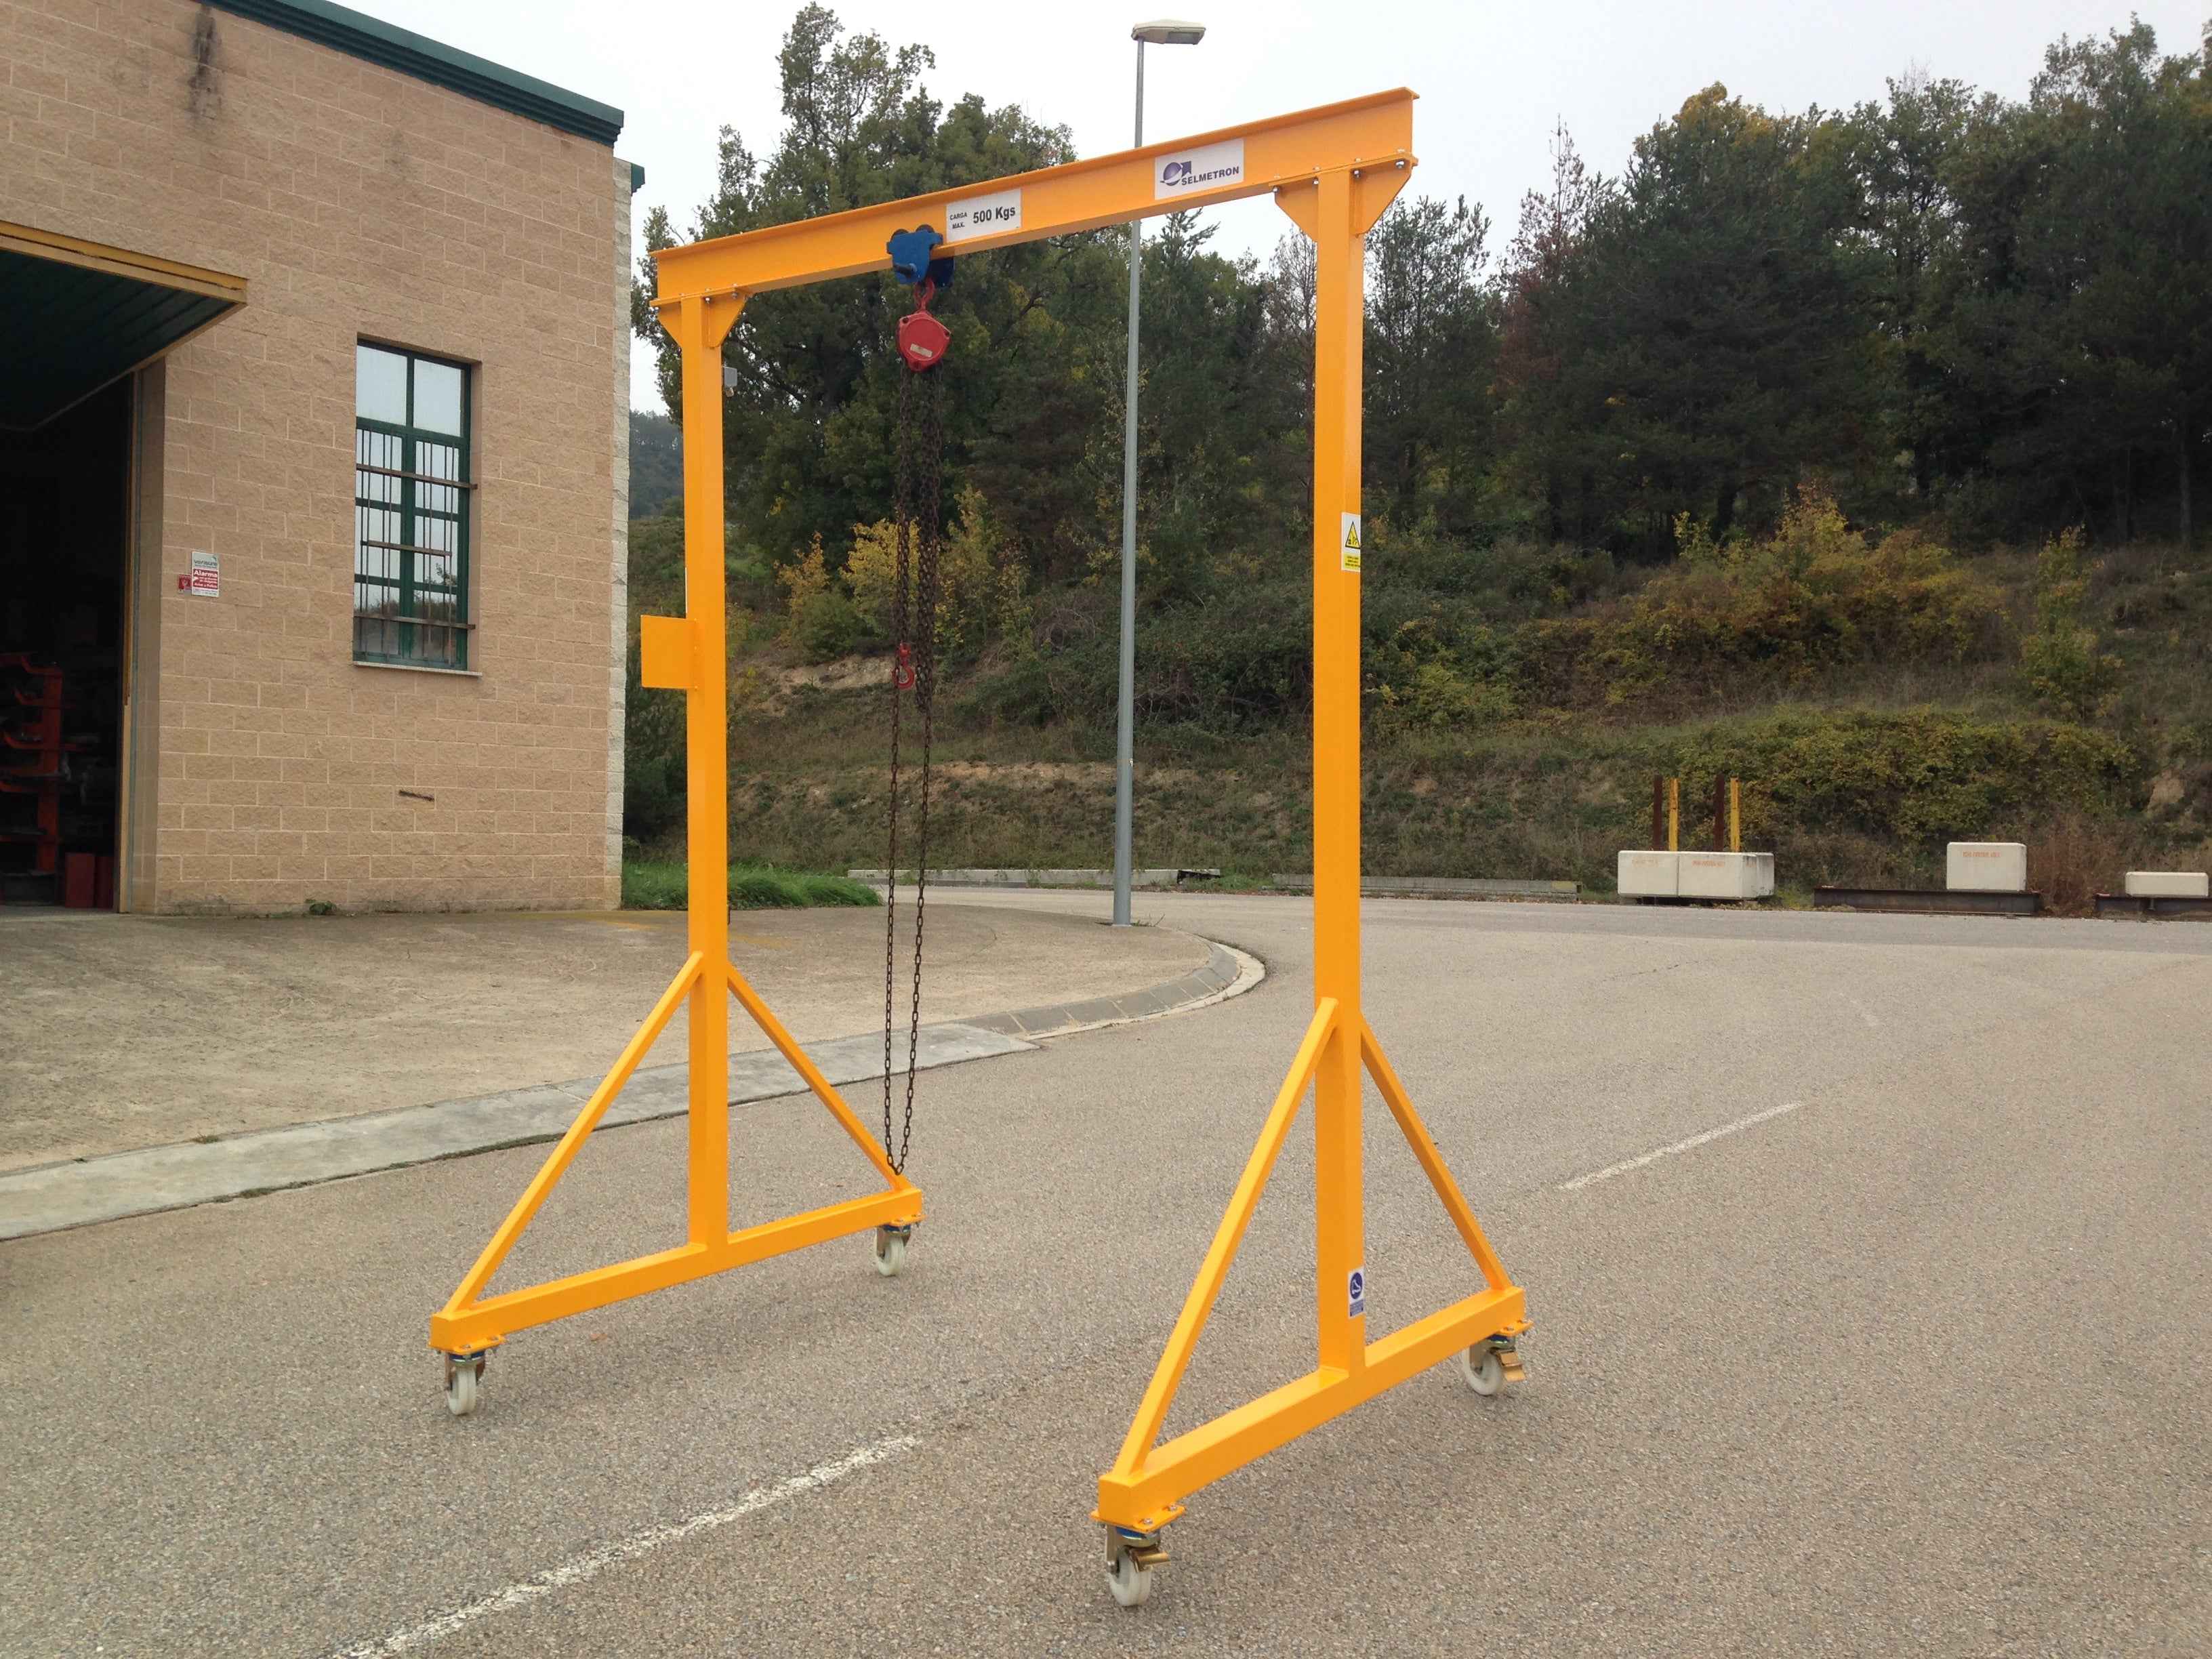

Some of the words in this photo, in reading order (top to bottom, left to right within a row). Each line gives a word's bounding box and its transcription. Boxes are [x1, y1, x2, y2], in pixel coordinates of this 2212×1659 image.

[1181, 166, 1240, 186] SELMETRON
[949, 212, 967, 220] CARGA
[973, 209, 992, 224] 500
[996, 206, 1015, 221] Kgs
